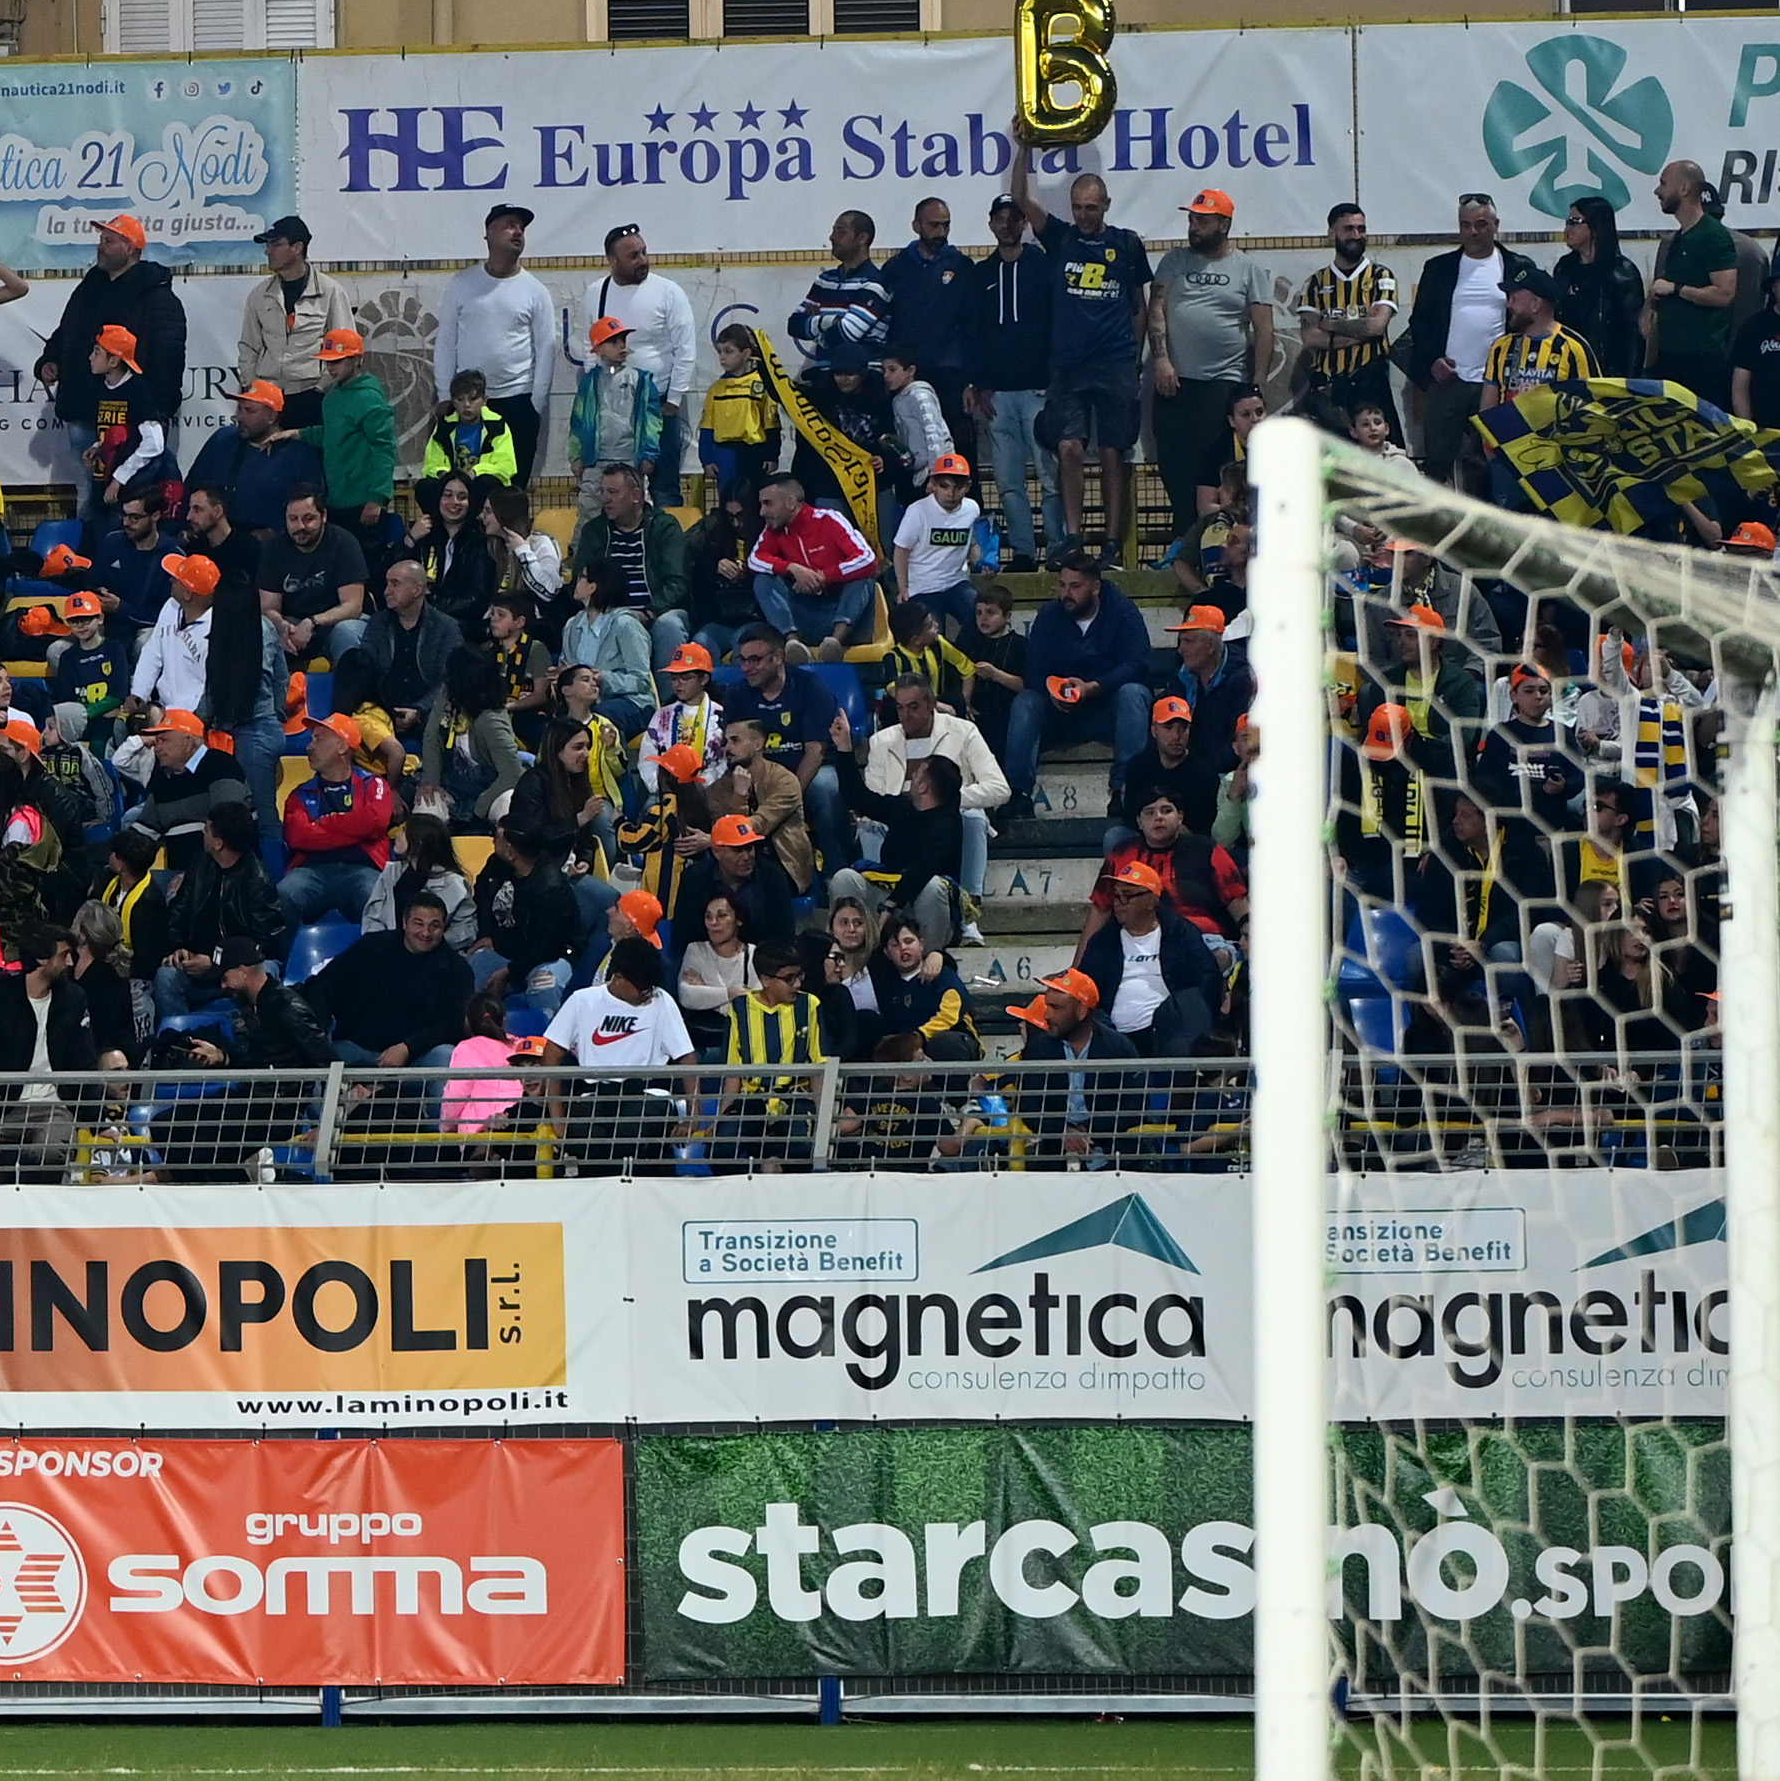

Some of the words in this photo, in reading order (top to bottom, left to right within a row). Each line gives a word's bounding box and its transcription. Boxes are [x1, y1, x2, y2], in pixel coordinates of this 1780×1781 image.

[77, 140, 125, 190] 21
[138, 124, 258, 202] Nodi
[533, 123, 816, 201] Europa
[841, 113, 1082, 180] Staba
[1110, 103, 1316, 172] Hotel
[47, 216, 65, 234] la
[170, 212, 256, 236] giusta...
[1038, 869, 1053, 897] 7
[1016, 956, 1032, 981] 6
[600, 1014, 639, 1035] NIKE
[698, 1229, 838, 1252] Transizione
[1327, 1221, 1443, 1241] ansizione
[698, 1256, 713, 1274] a
[720, 1248, 816, 1274] Società
[821, 1249, 905, 1274] Benefit
[1424, 1240, 1512, 1262] Benefit
[496, 1261, 523, 1346] s.r.l.
[689, 1271, 1206, 1392] magnetica
[907, 1363, 1068, 1391] consulenza
[236, 1387, 569, 1418] www.laminopoli.it
[245, 1510, 423, 1546] gruppo
[107, 1553, 548, 1616] somma
